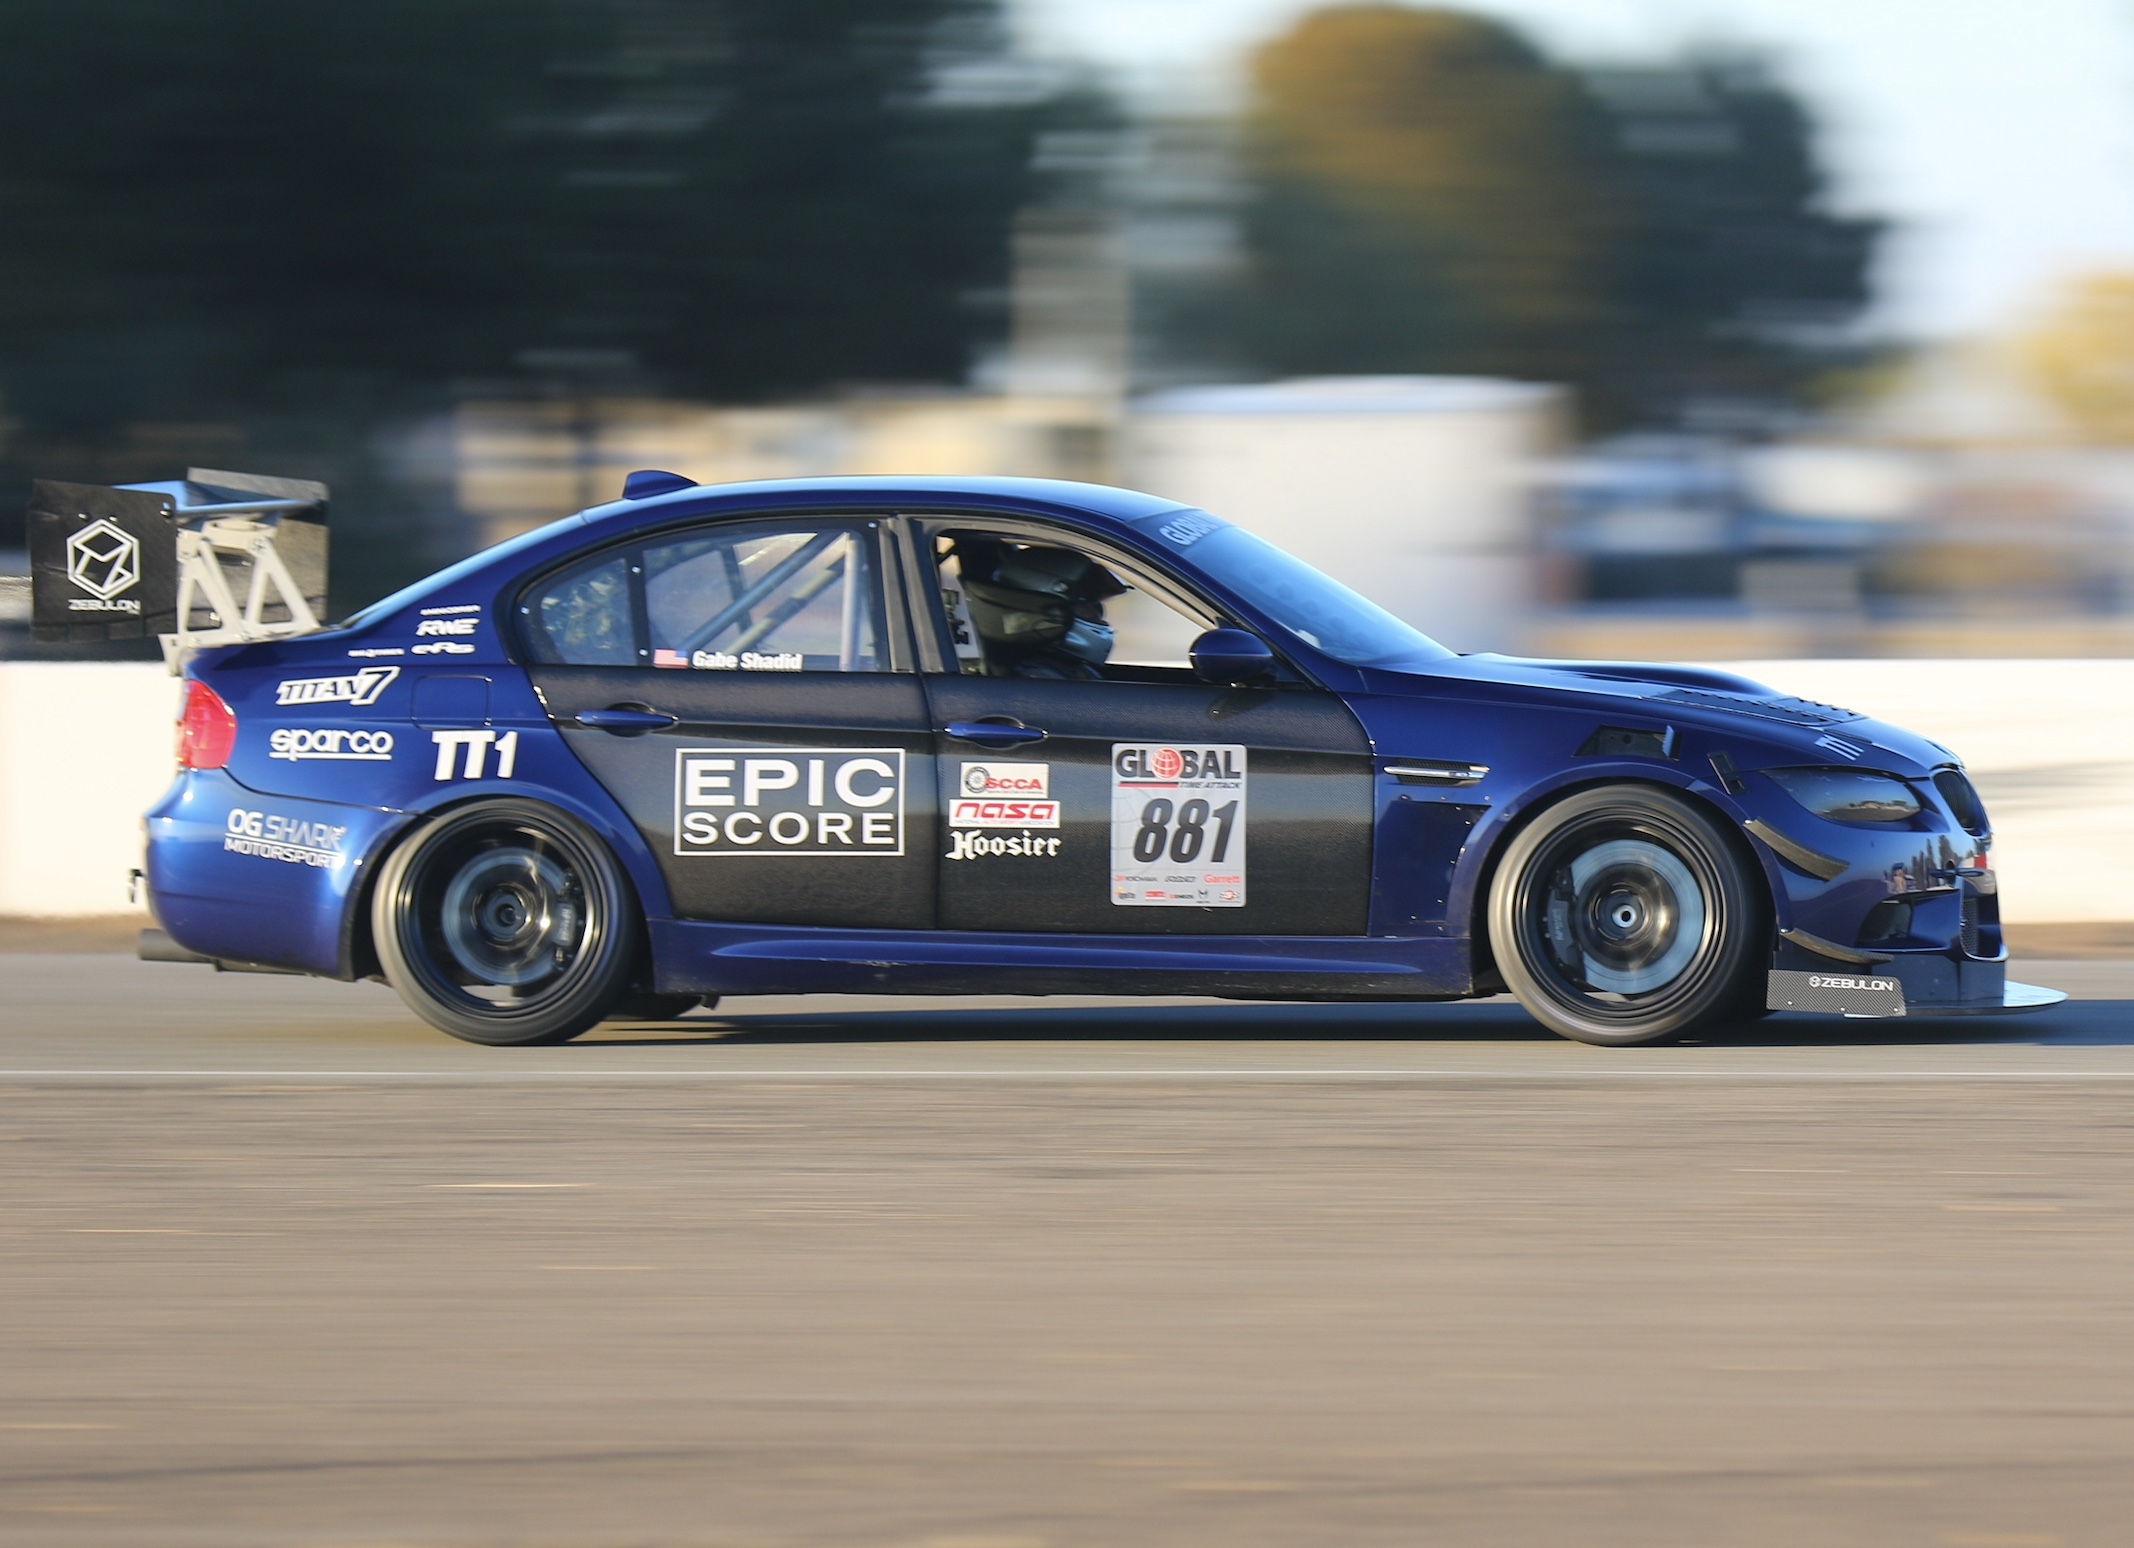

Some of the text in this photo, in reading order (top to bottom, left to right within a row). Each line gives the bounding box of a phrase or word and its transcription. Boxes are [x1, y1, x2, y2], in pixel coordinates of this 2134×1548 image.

[67, 599, 141, 614] ZEBULON
[692, 650, 803, 672] Gabe Shadid
[269, 728, 394, 762] sparco
[432, 729, 518, 781] TT1
[1115, 747, 1242, 780] GLOBAL
[685, 757, 896, 808] EPIC
[984, 777, 1043, 790] SCCA
[1179, 781, 1241, 789] TIME ATTACK
[227, 808, 348, 852] OG SHARK
[681, 811, 896, 846] SCORE
[1133, 797, 1240, 864] 881
[223, 838, 345, 870] MOTORSPORT
[944, 829, 1062, 861] Hoosier
[1821, 977, 1893, 991] ZEBULON
